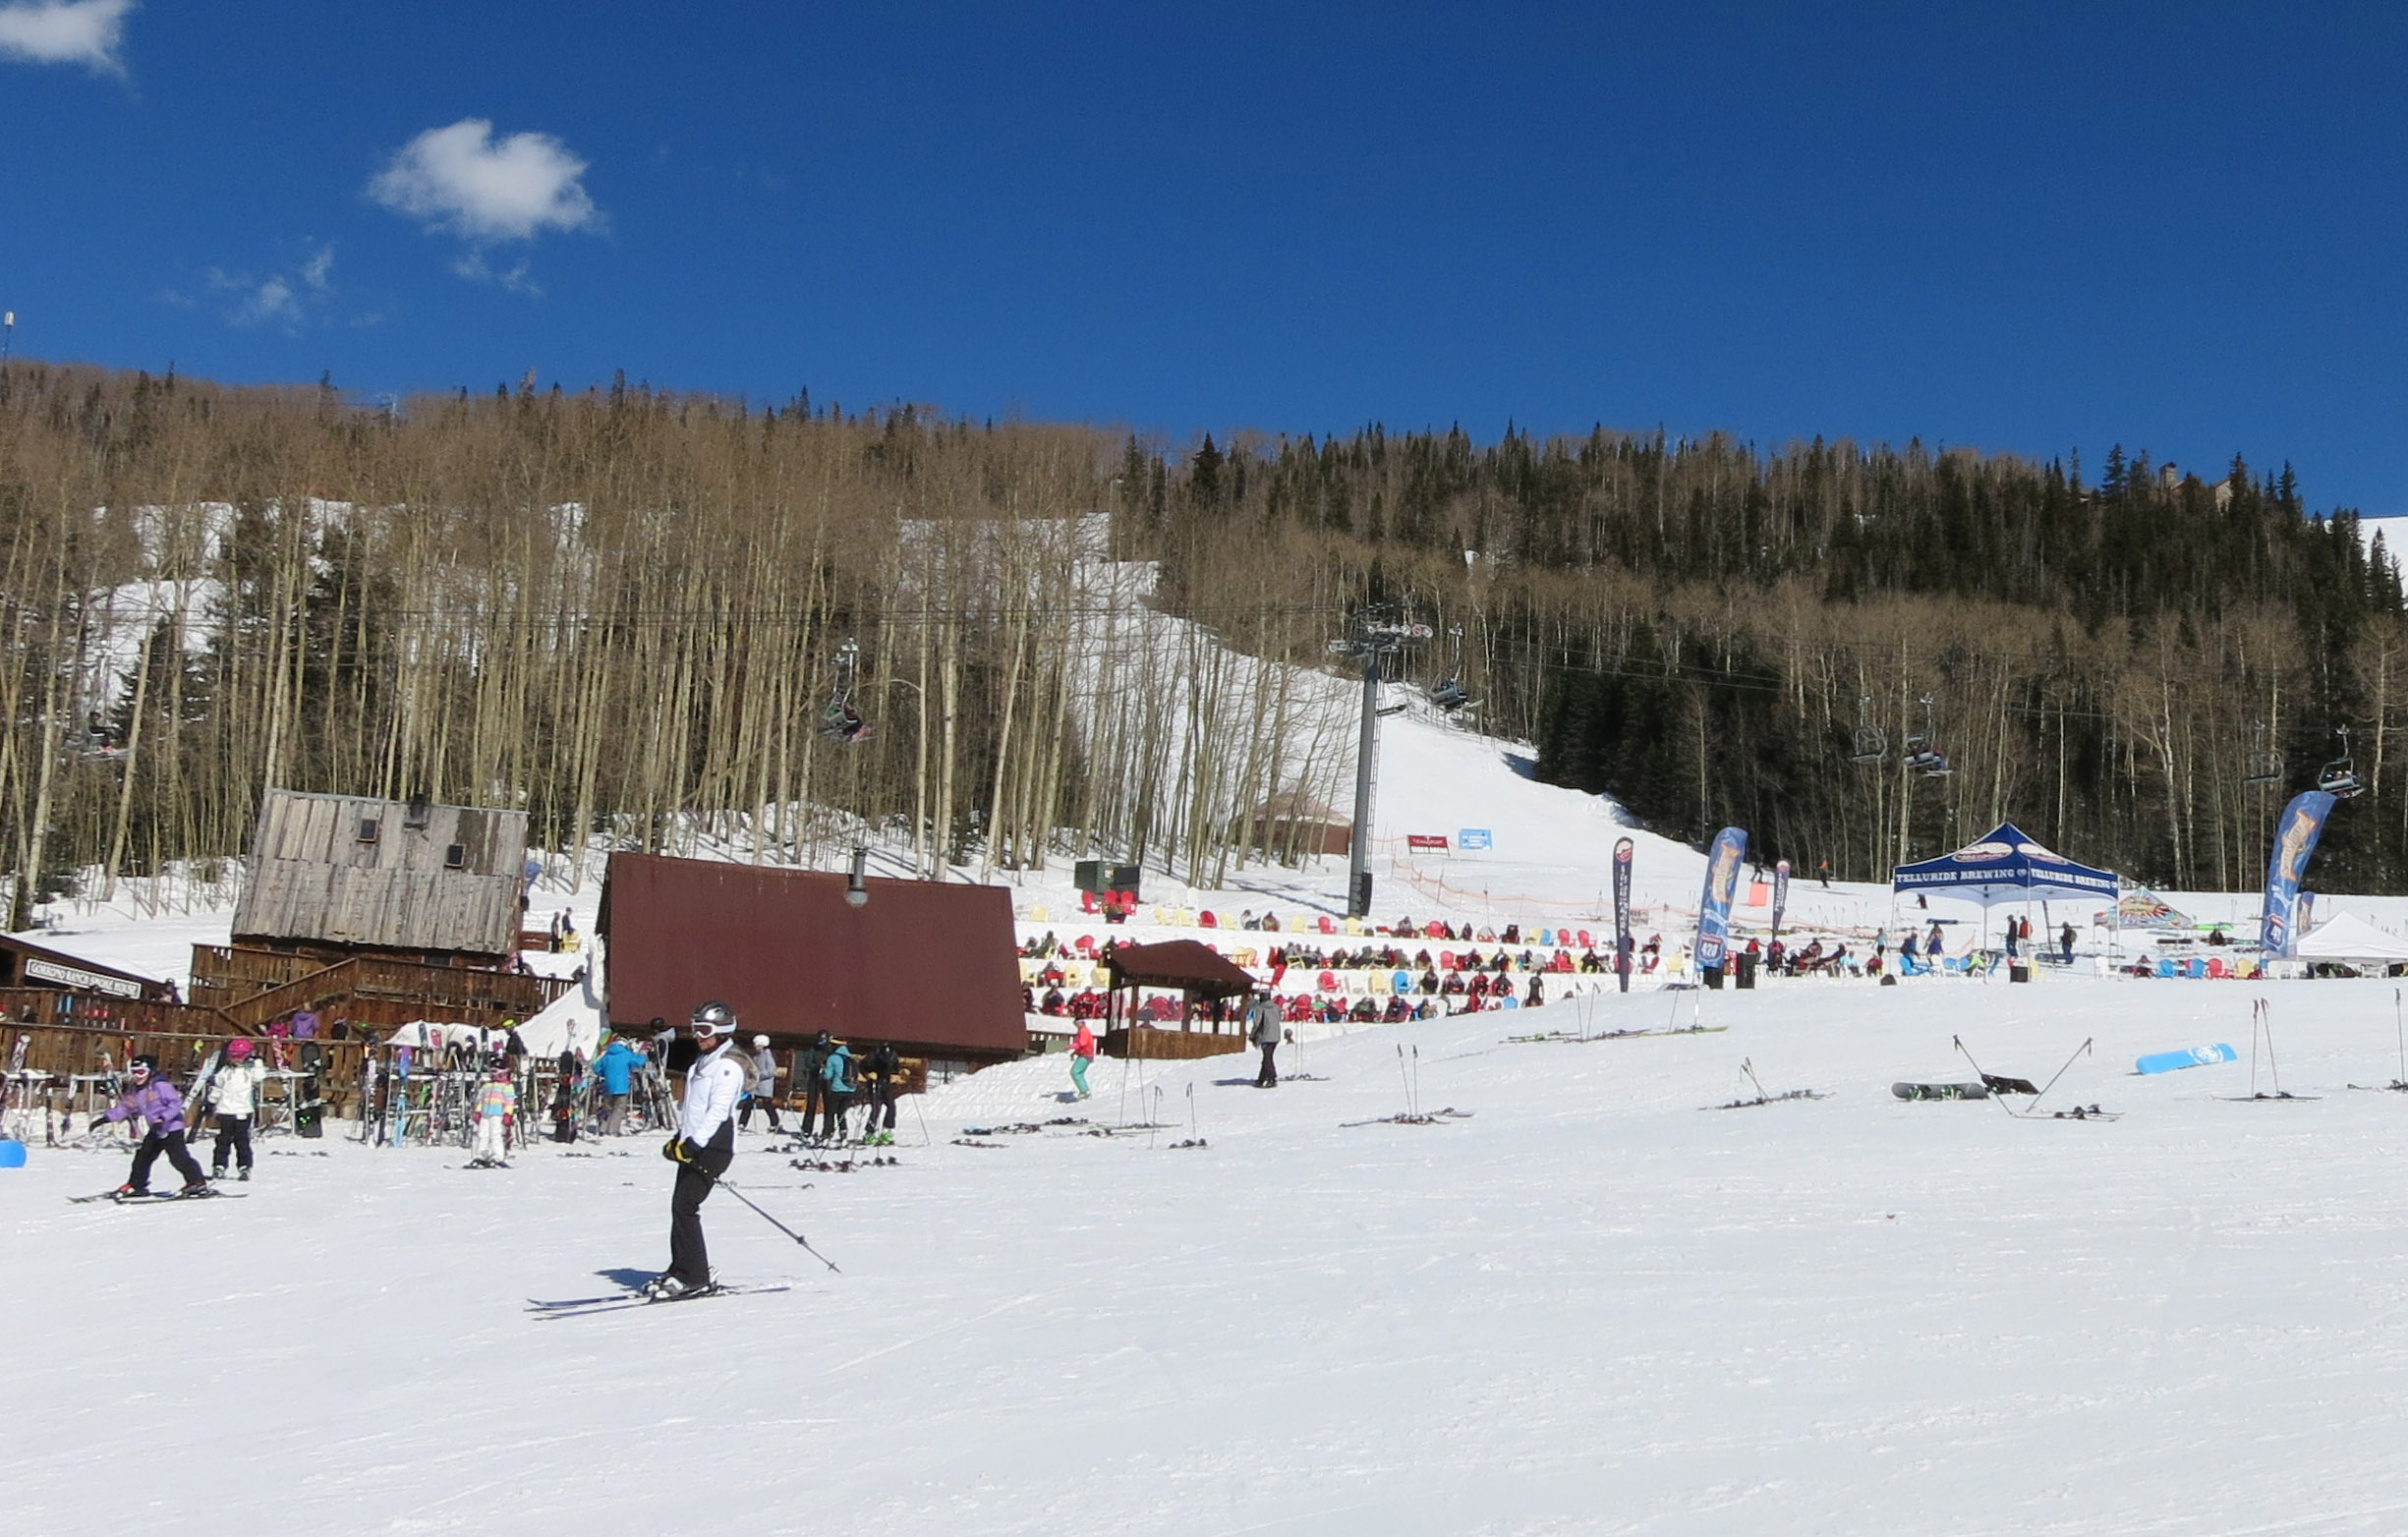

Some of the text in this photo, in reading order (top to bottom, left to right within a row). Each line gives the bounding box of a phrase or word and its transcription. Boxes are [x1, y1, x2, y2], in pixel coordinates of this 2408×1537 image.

[1896, 871, 1957, 882] TELLURIDE
[1960, 869, 2015, 881] BREWING
[2031, 868, 2074, 883] TELLURIDE
[2075, 875, 2110, 889] BREWING
